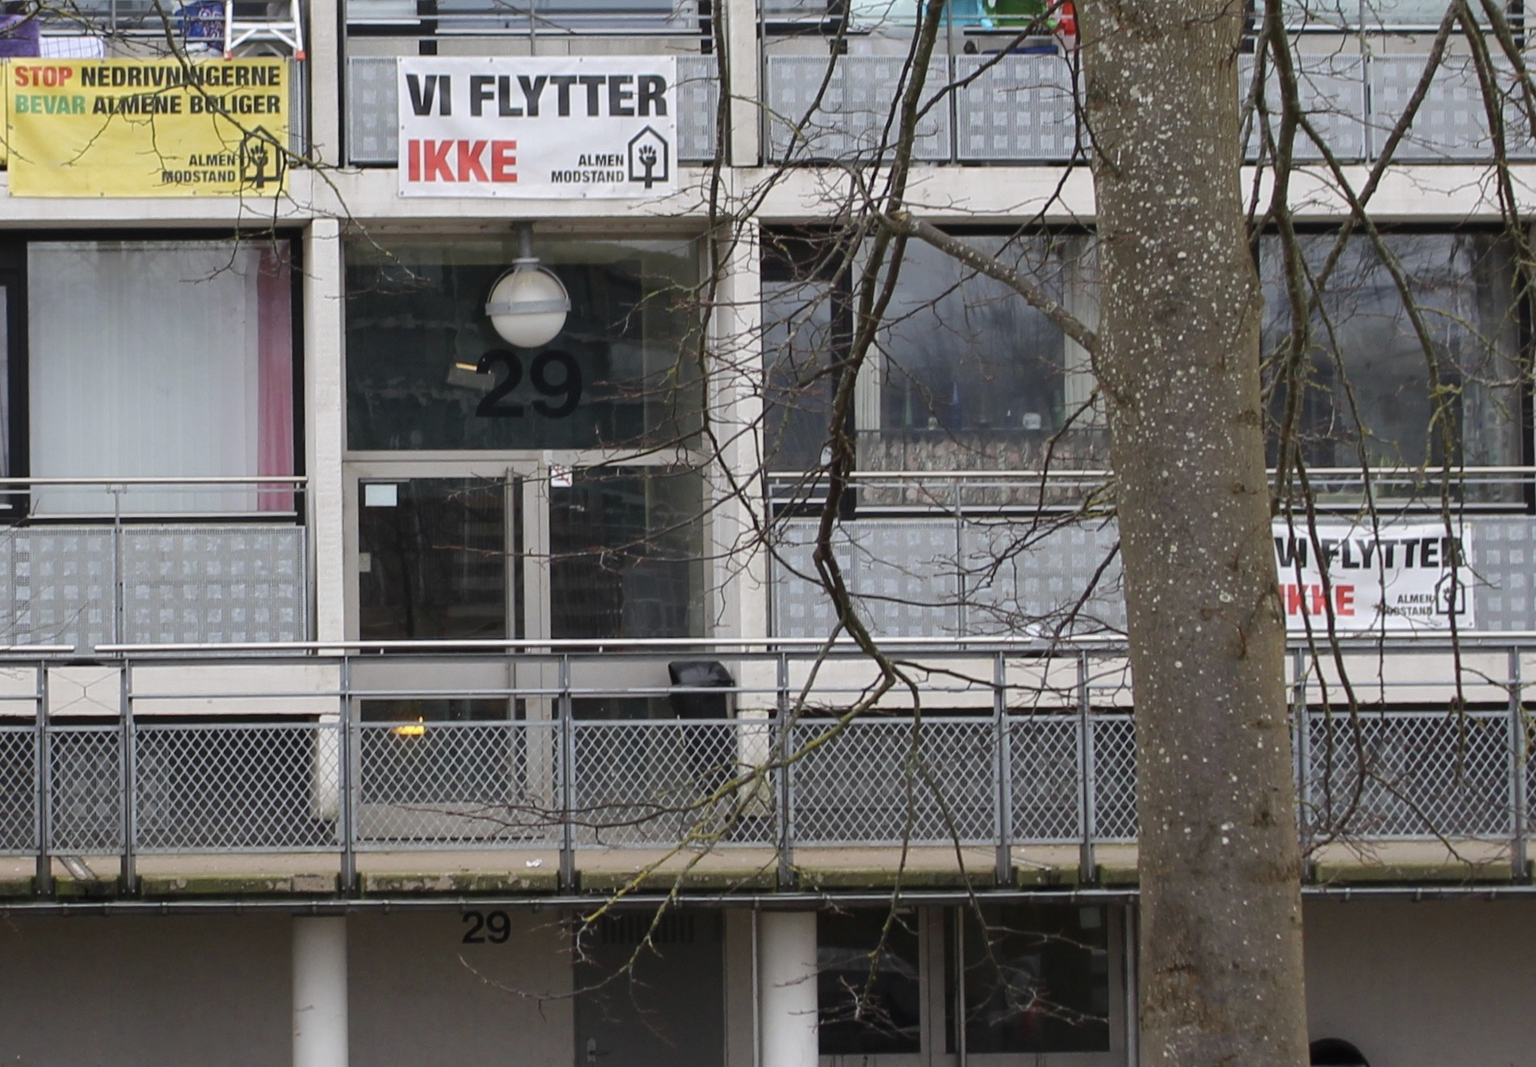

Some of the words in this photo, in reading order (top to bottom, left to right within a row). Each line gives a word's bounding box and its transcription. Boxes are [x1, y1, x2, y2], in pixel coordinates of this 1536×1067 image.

[15, 65, 73, 87] STOP
[81, 66, 280, 87] NEDRIVNINGERNE
[16, 94, 86, 115] BEVAR
[93, 94, 182, 115] ALMENE
[190, 95, 280, 115] BOLIGER
[406, 74, 451, 116] VI
[470, 75, 668, 117] FLYTTER
[189, 154, 236, 167] ALMEN
[408, 139, 518, 183] IKKE
[578, 154, 625, 167] ALMEN
[162, 170, 236, 183] MODSTAND
[551, 170, 625, 183] MODSTAND
[475, 348, 582, 418] 29
[1275, 537, 1307, 569] VI
[1321, 537, 1463, 570] FLYTTER
[1397, 593, 1433, 605] ALMEN
[462, 910, 511, 944] 29
